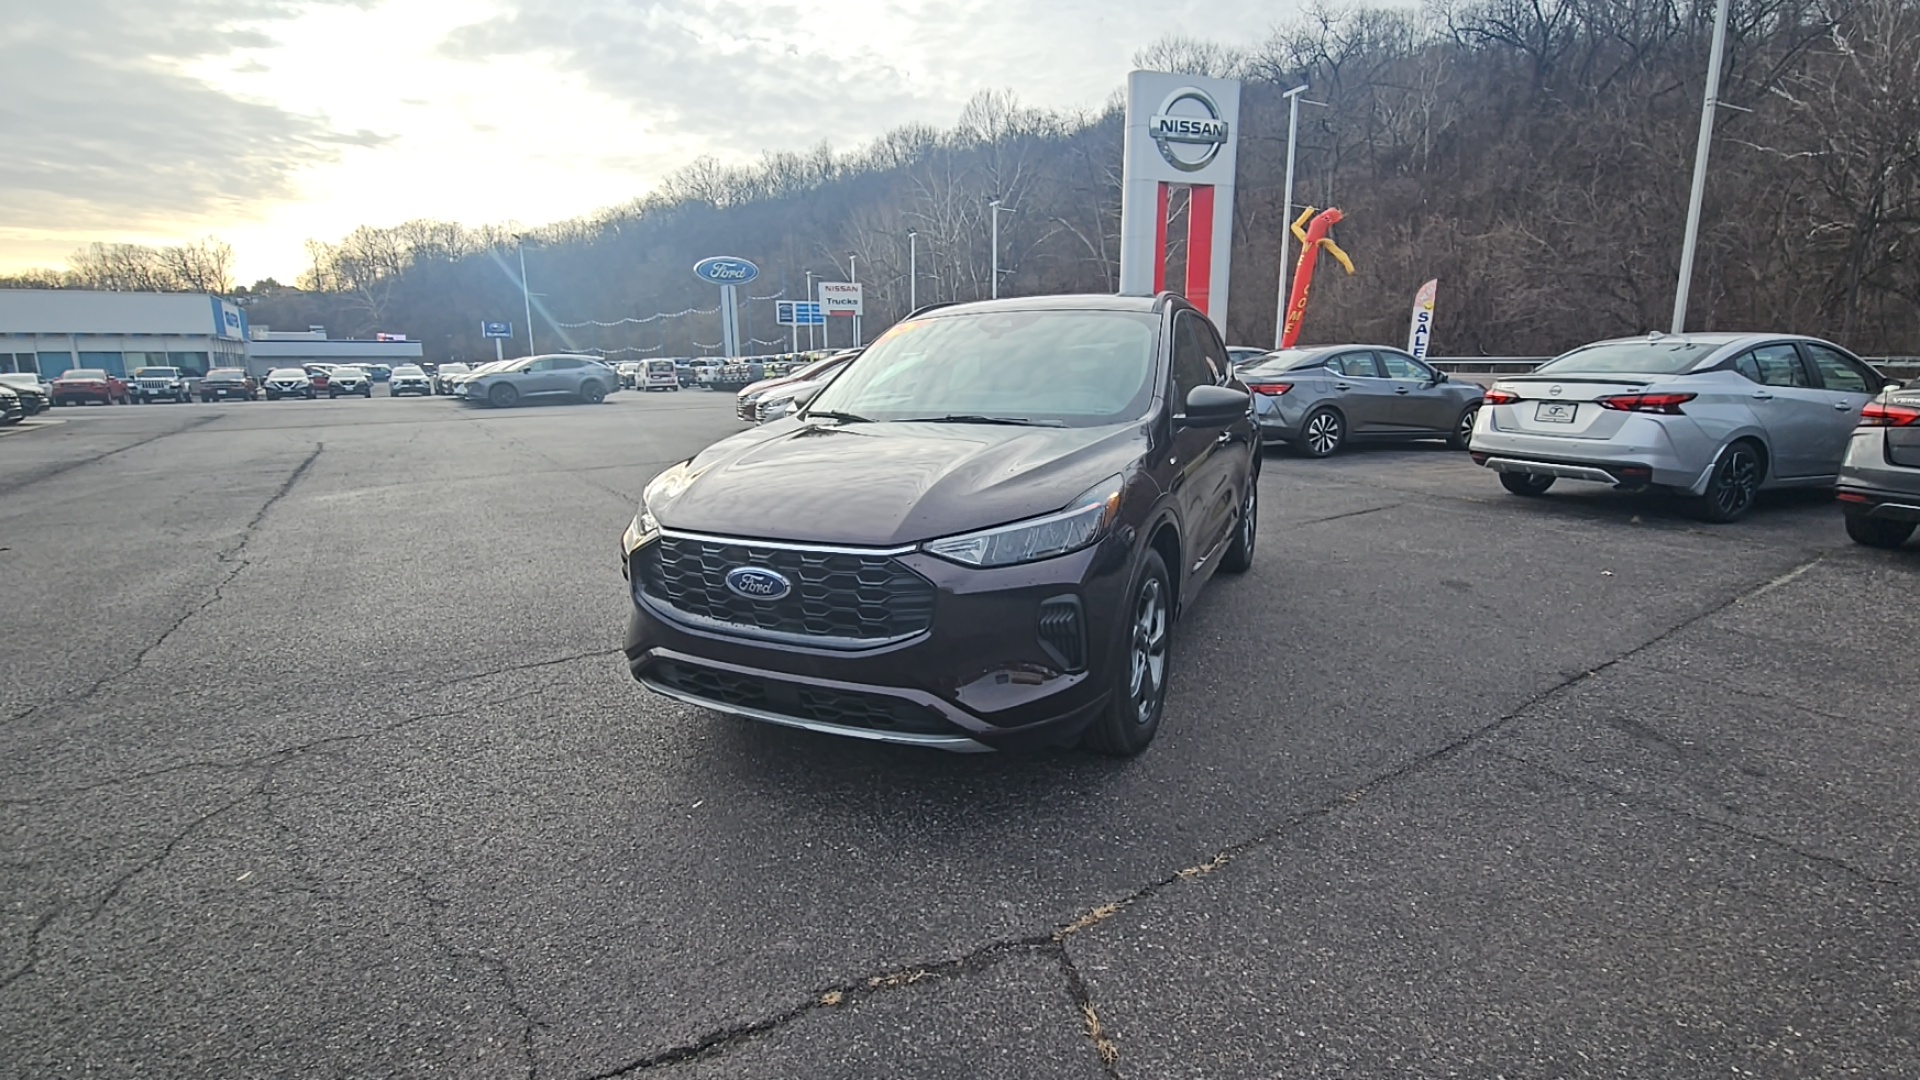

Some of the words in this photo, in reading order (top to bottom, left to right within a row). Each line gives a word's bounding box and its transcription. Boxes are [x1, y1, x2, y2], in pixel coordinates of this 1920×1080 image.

[1160, 119, 1223, 137] NISSAN
[709, 261, 746, 279] Ford
[826, 297, 859, 305] Trucks
[1413, 311, 1429, 358] SALE
[739, 573, 773, 594] Ford
